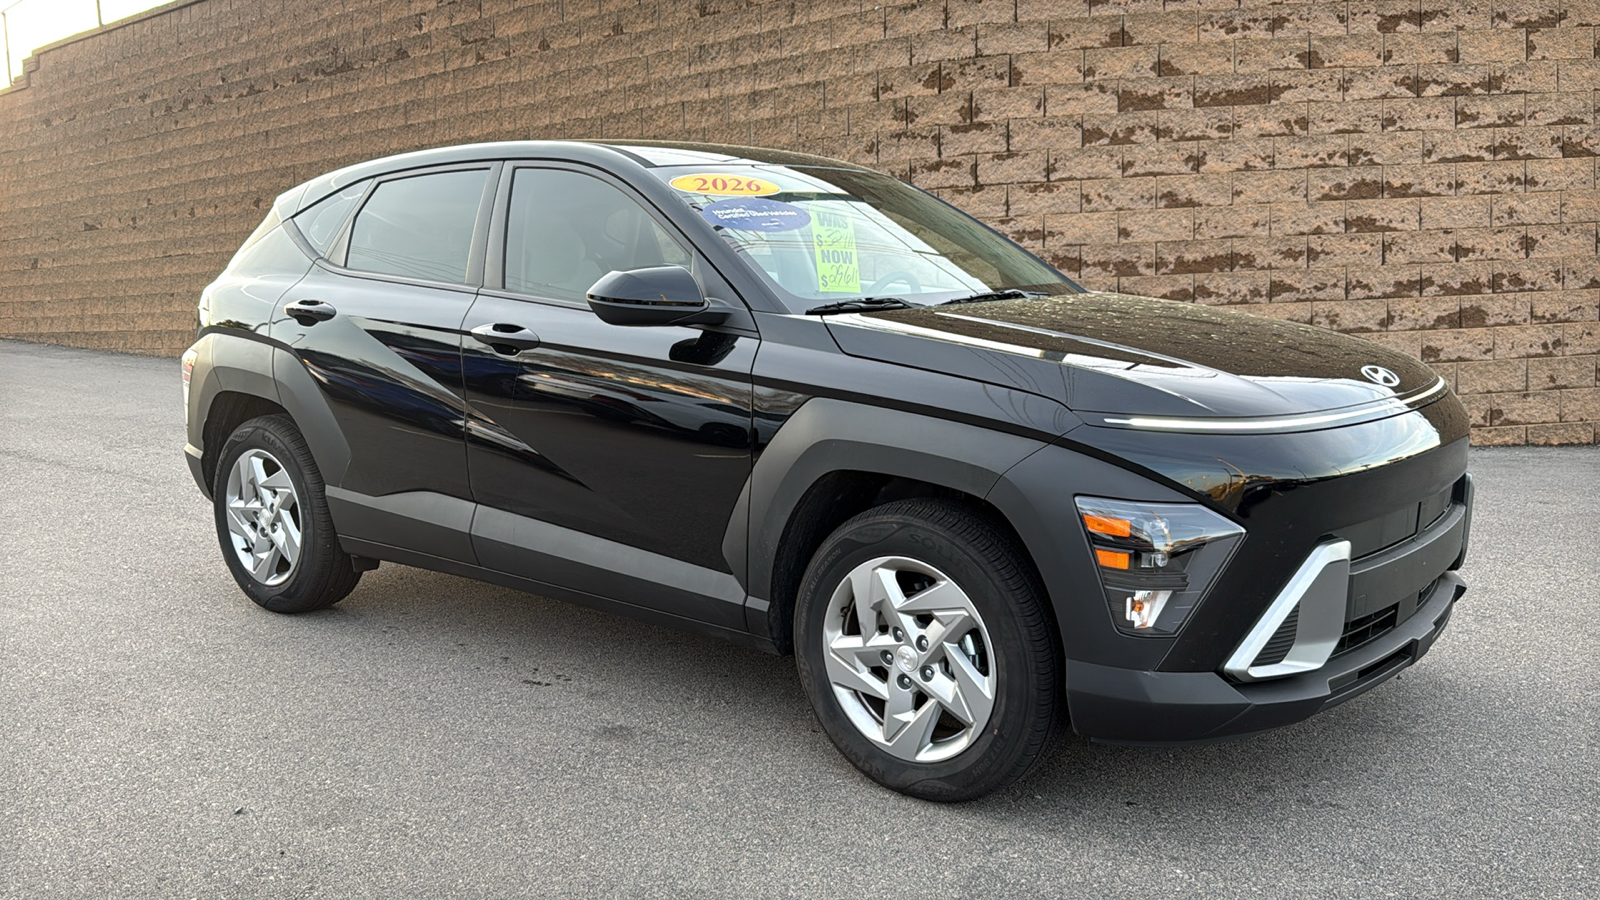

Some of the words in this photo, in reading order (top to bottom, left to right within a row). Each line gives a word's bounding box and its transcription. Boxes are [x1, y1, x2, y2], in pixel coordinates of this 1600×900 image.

[693, 177, 761, 192] 2026
[712, 208, 746, 216] Hyundai
[718, 211, 750, 220] Certified
[816, 212, 849, 229] WAS
[820, 249, 853, 265] NOW
[810, 547, 843, 592] ALL-SEASON
